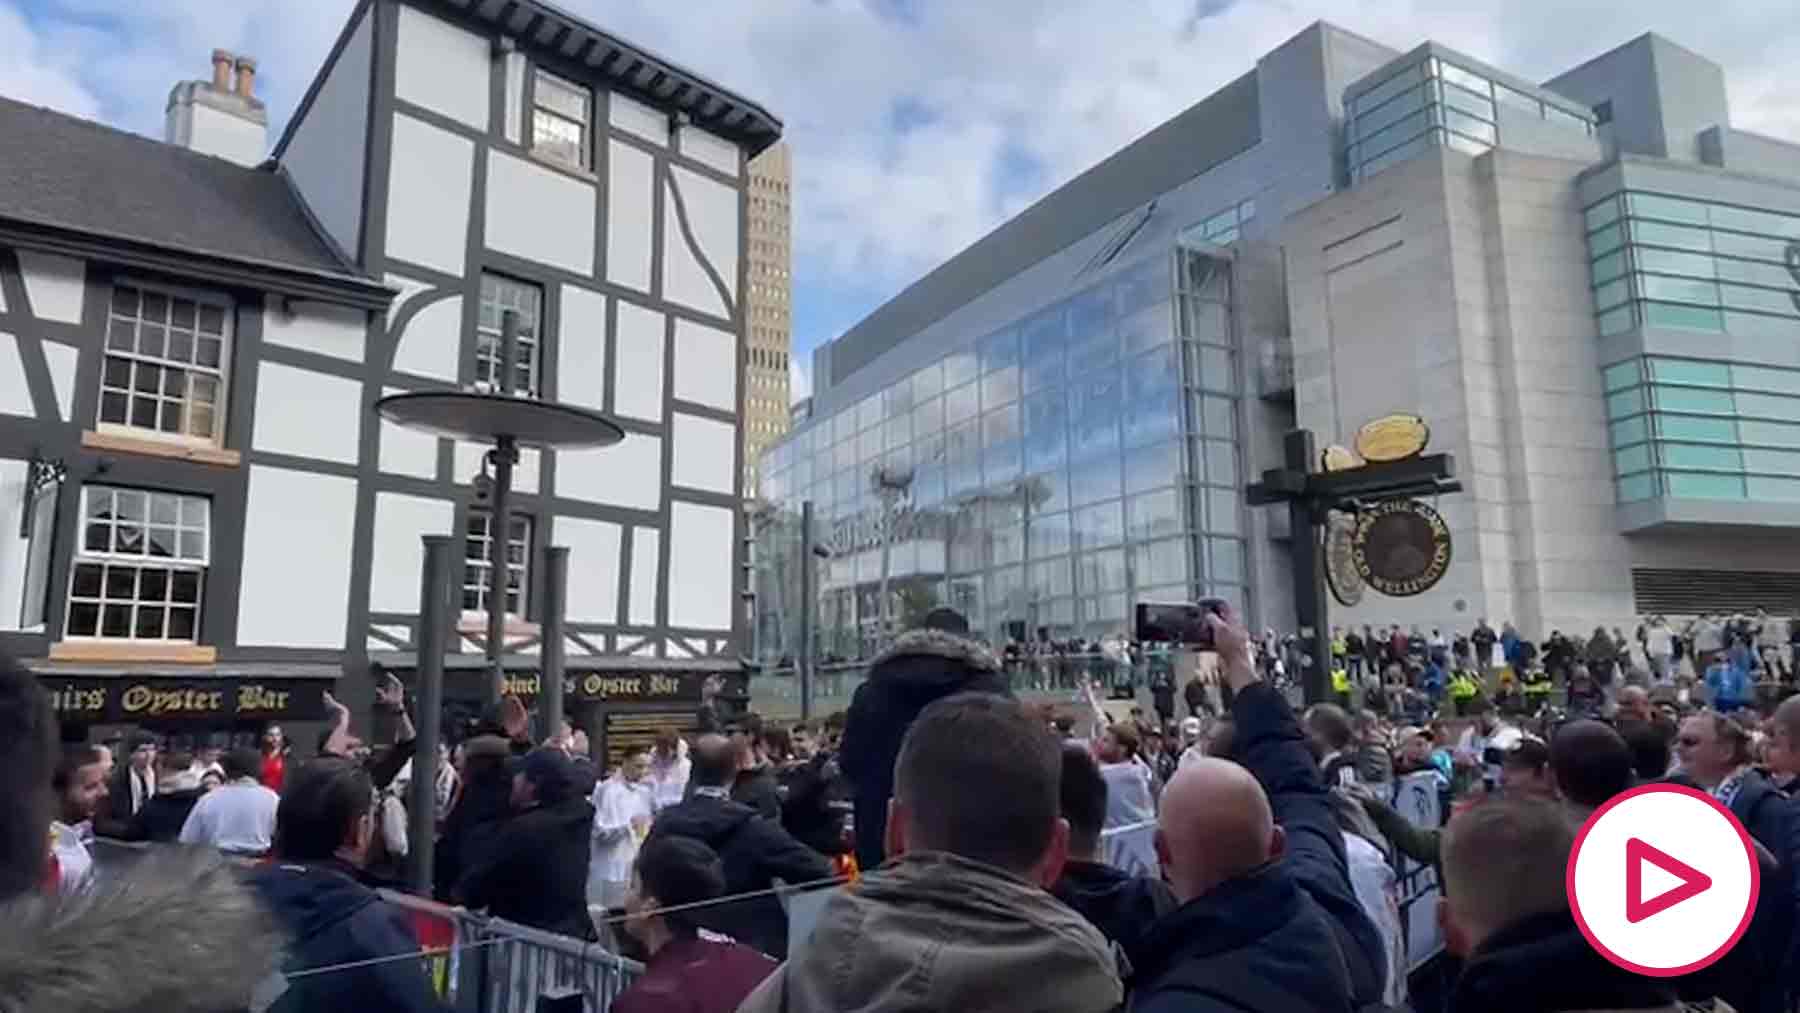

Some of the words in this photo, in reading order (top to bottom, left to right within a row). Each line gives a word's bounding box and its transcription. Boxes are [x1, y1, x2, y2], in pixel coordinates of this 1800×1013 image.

[121, 684, 222, 714] Oyster
[236, 685, 289, 711] Bar
[584, 673, 641, 698] Oyster
[650, 674, 679, 694] Bar
